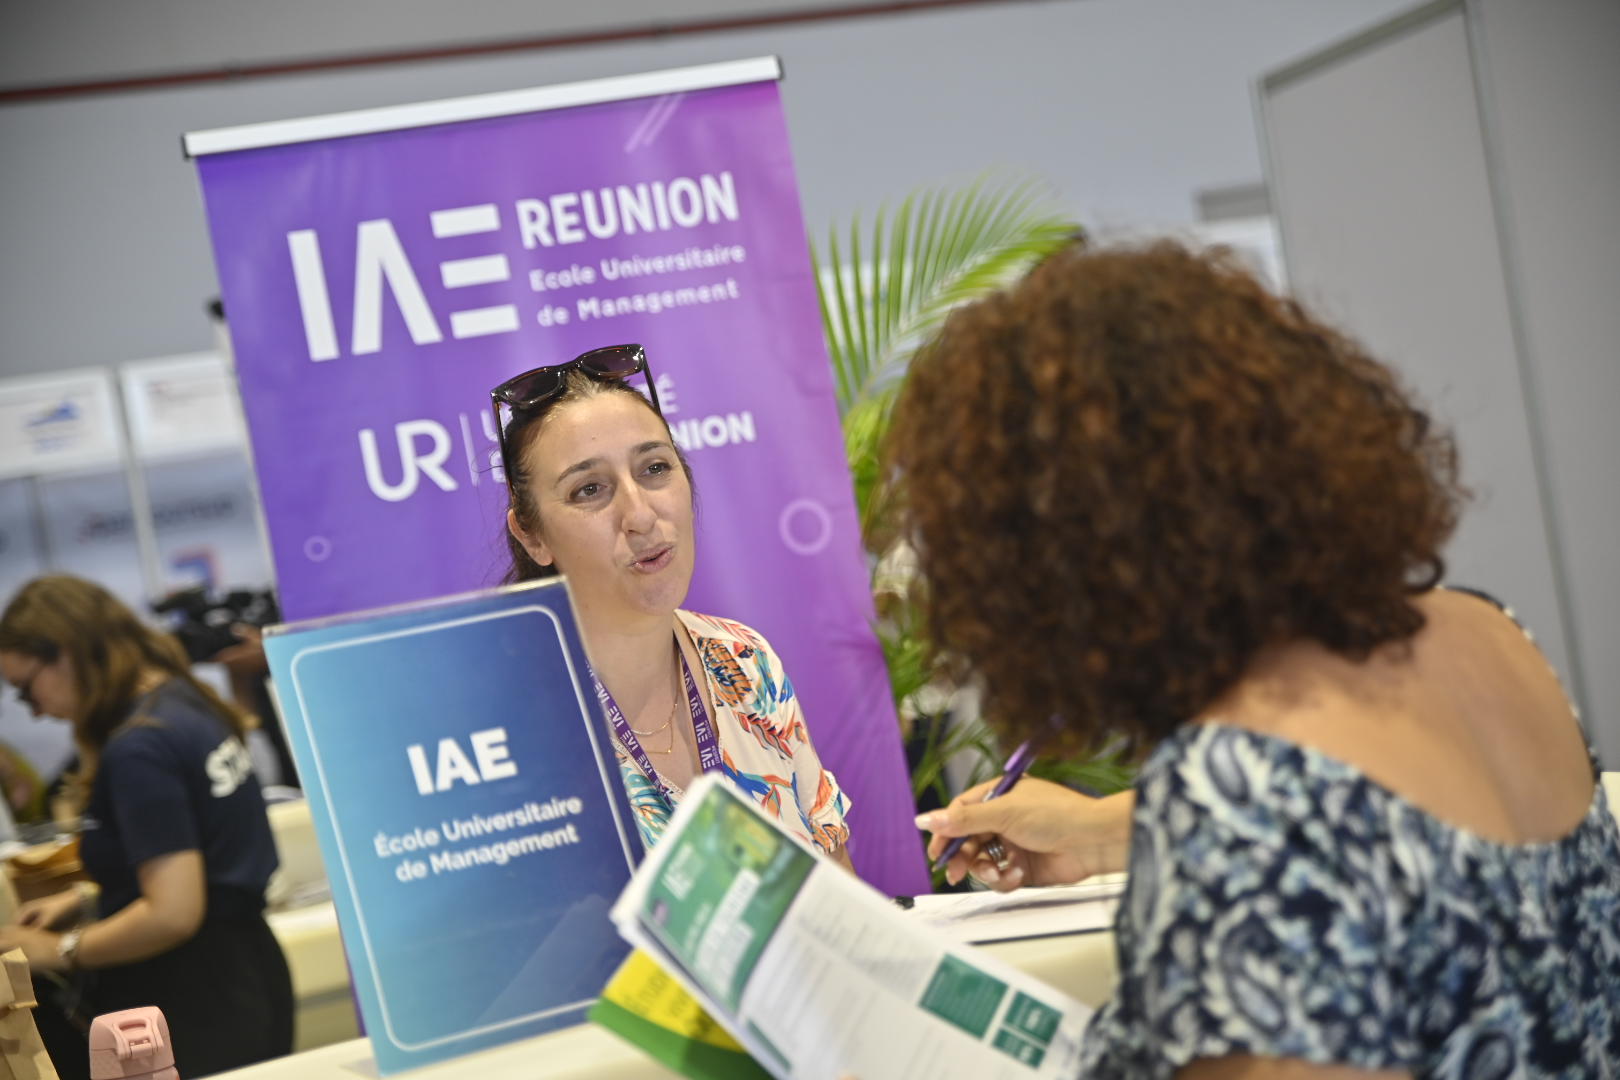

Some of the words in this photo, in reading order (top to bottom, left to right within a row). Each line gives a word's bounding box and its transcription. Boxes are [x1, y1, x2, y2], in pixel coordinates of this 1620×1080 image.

[515, 171, 740, 250] REUNION
[287, 204, 520, 361] IAE
[529, 264, 597, 292] Ecole
[600, 244, 746, 281] Universitaire
[537, 304, 570, 328] de
[576, 277, 740, 322] Management
[358, 419, 458, 502] UR
[667, 410, 757, 452] NION
[406, 727, 519, 796] IAE
[373, 828, 440, 858] École
[442, 796, 584, 843] Universitaire
[395, 859, 428, 883] de
[429, 823, 580, 875] Management
